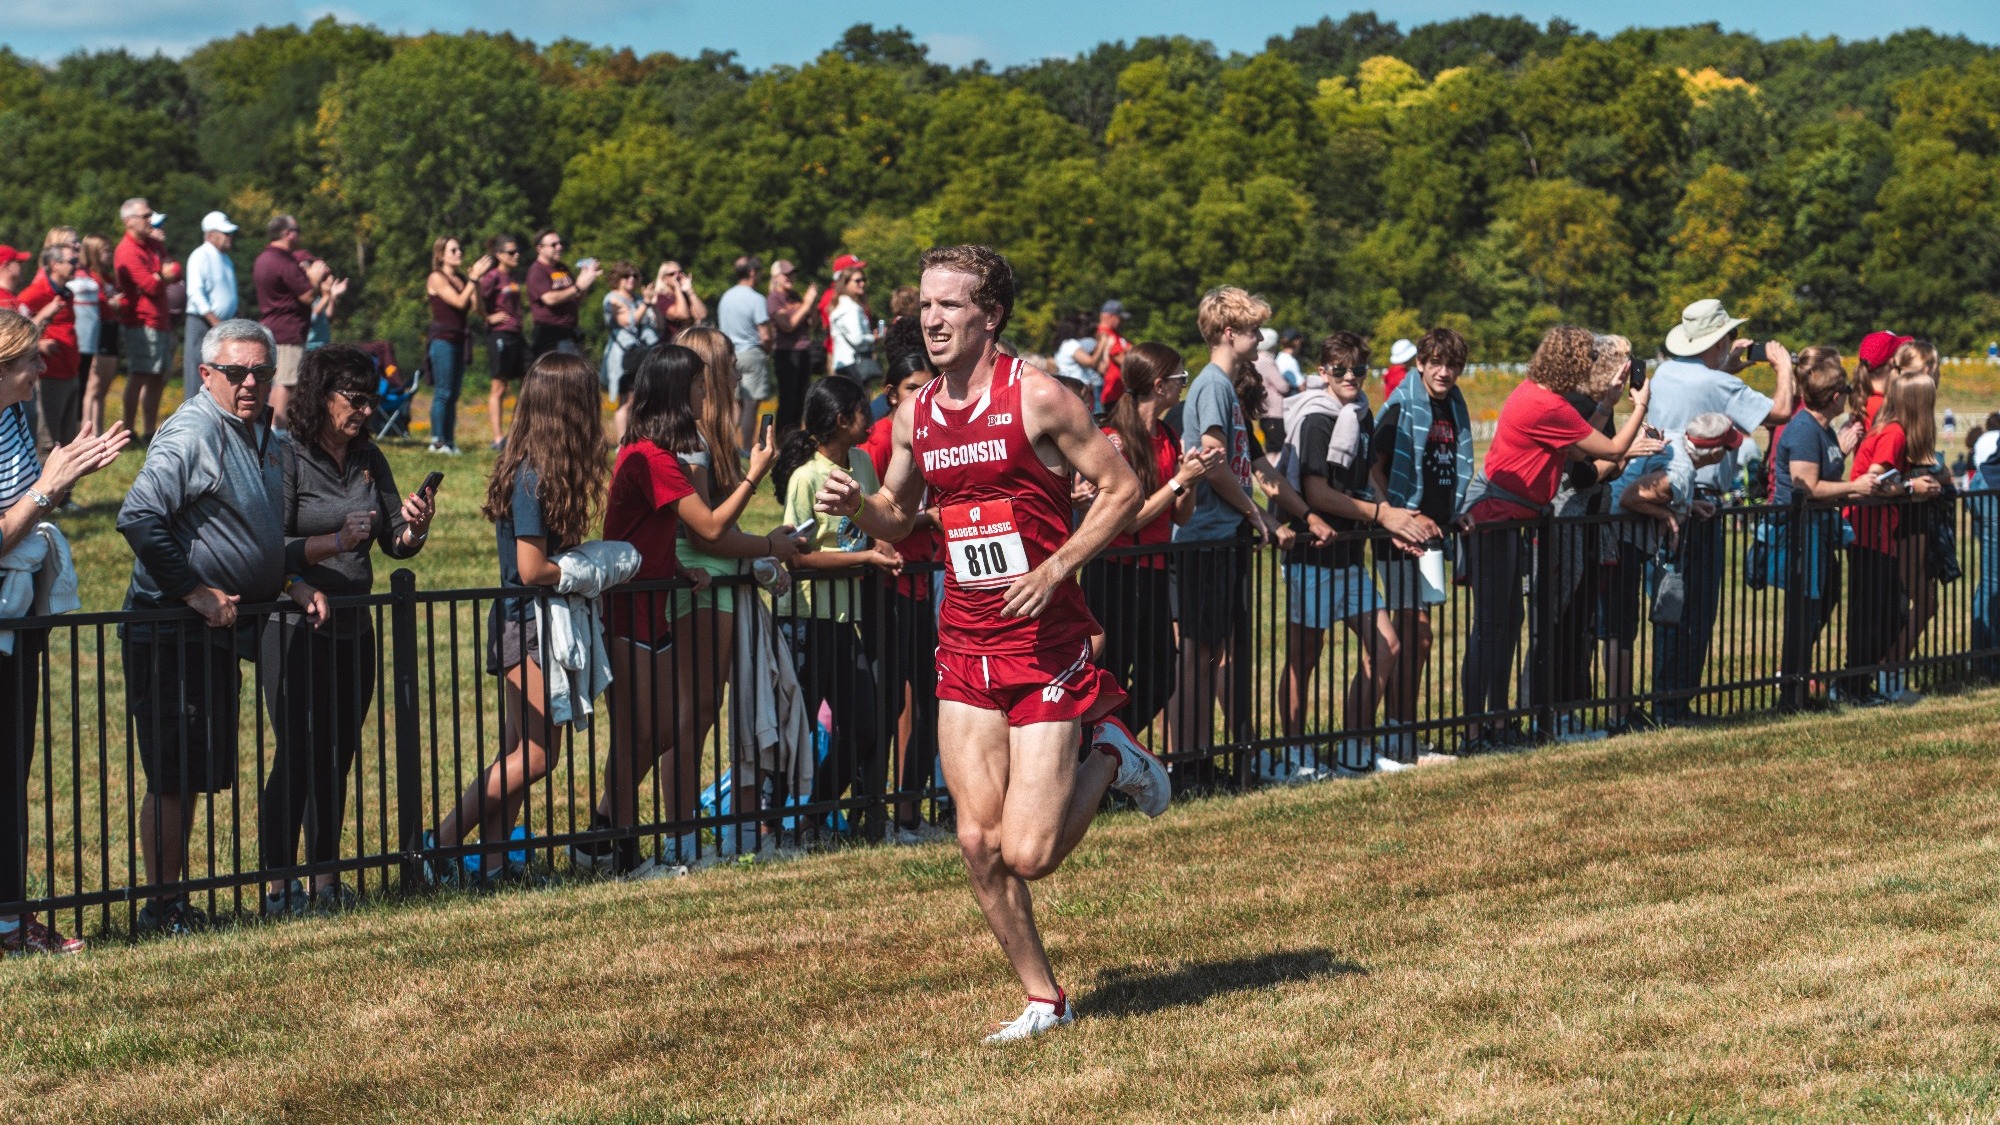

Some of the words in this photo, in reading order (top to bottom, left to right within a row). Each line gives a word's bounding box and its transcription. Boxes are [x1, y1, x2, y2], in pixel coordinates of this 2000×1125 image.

[923, 438, 1008, 472] WISCONSIN
[969, 506, 981, 523] W
[948, 526, 979, 539] BADGER
[979, 521, 1013, 535] CLASSIC
[964, 541, 1008, 577] 810
[1042, 685, 1065, 704] W
